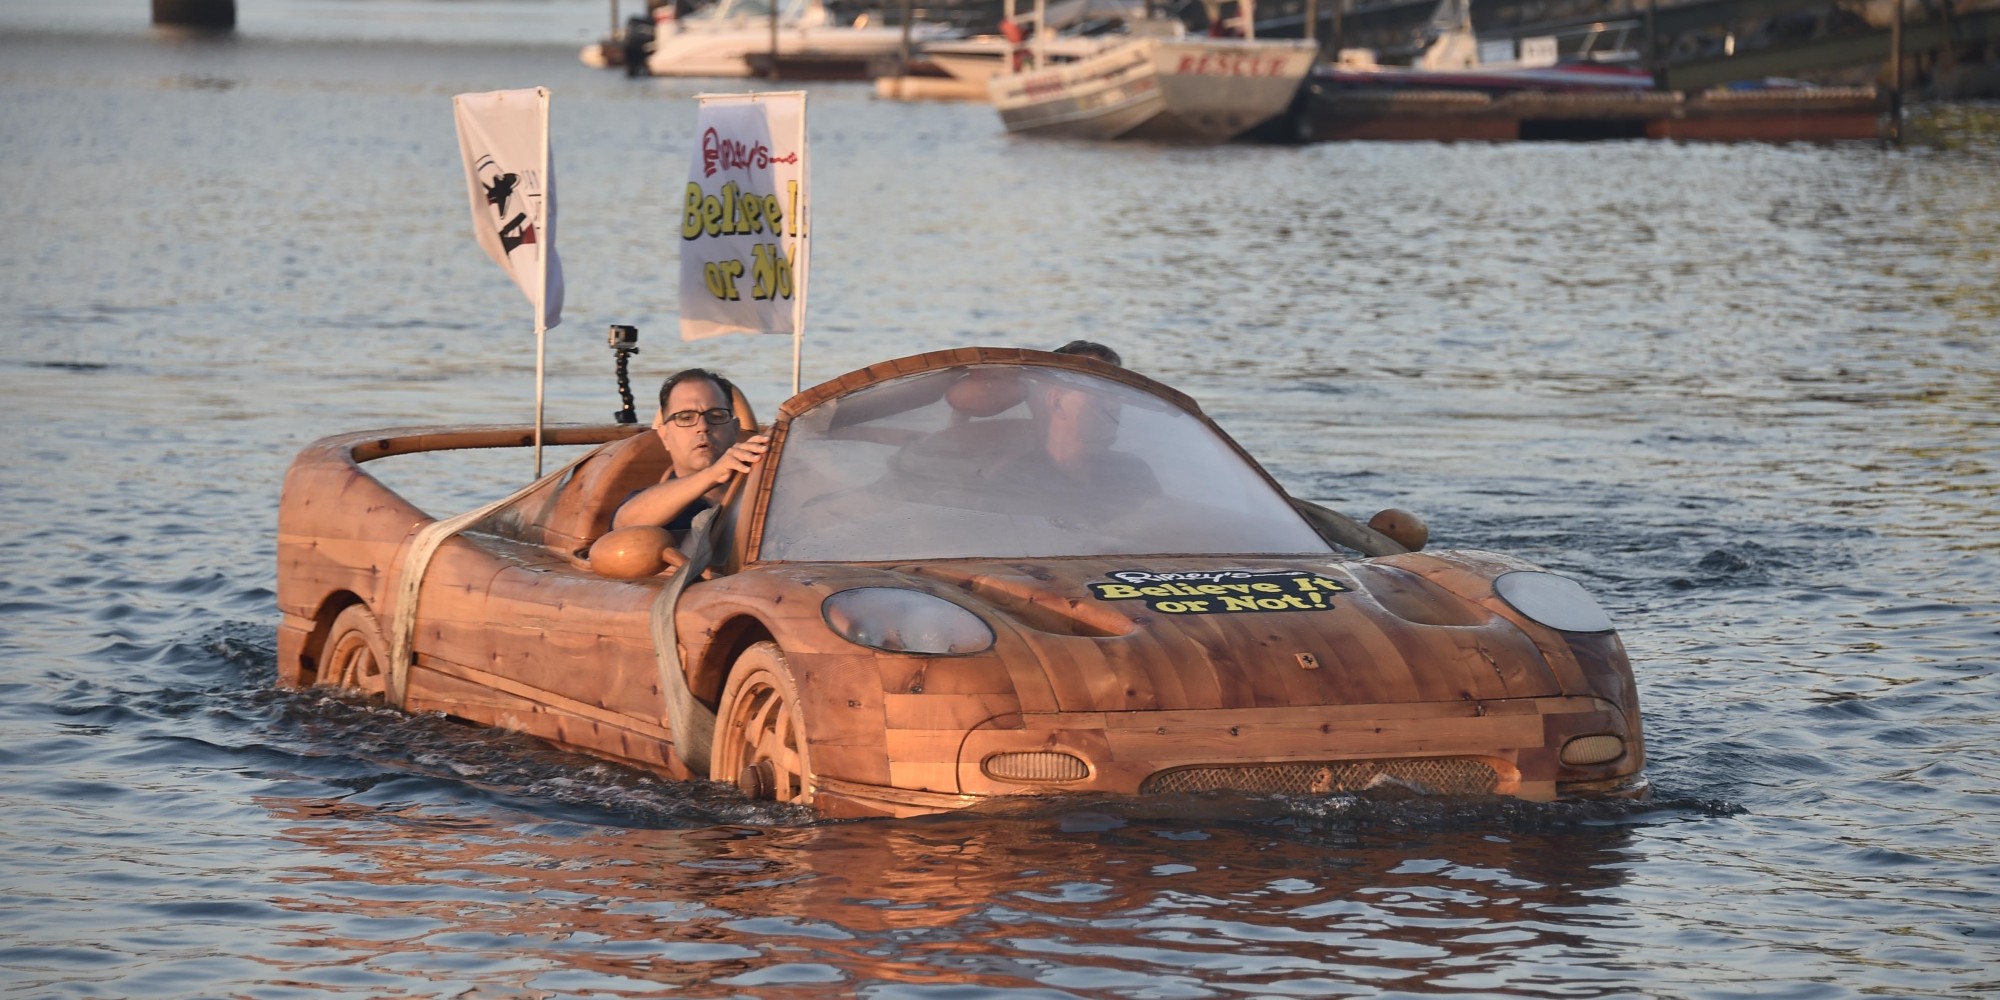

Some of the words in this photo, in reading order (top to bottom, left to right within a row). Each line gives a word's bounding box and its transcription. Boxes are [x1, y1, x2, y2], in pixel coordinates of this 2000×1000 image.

[1176, 55, 1288, 76] RESCUE
[682, 181, 782, 240] Beliee
[704, 260, 744, 300] or
[1096, 582, 1283, 599] Believe
[1293, 577, 1344, 592] It
[1155, 600, 1210, 613] or
[1217, 591, 1329, 612] Not!
